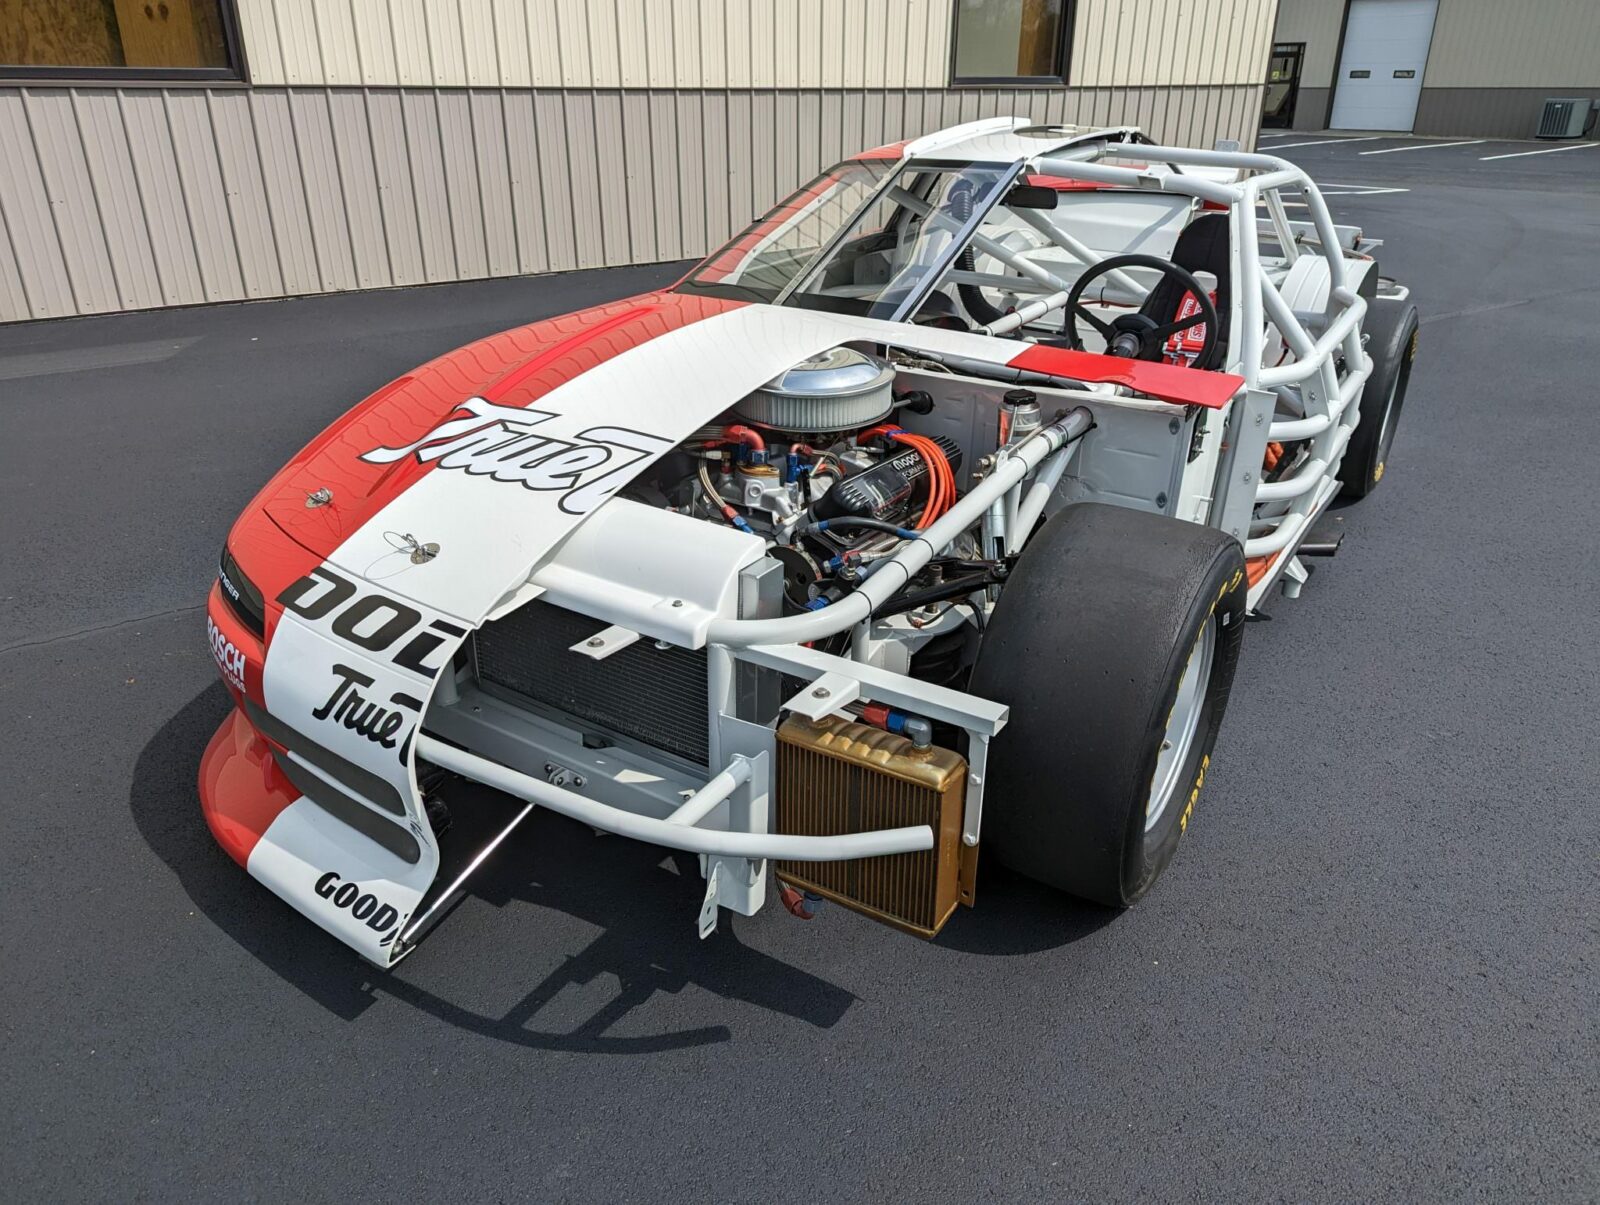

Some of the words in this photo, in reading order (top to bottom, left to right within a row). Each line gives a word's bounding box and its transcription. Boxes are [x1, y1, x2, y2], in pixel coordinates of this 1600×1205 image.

[893, 452, 920, 471] Mopar
[219, 566, 240, 601] NGER
[207, 615, 246, 682] BOSCH
[311, 663, 403, 749] True
